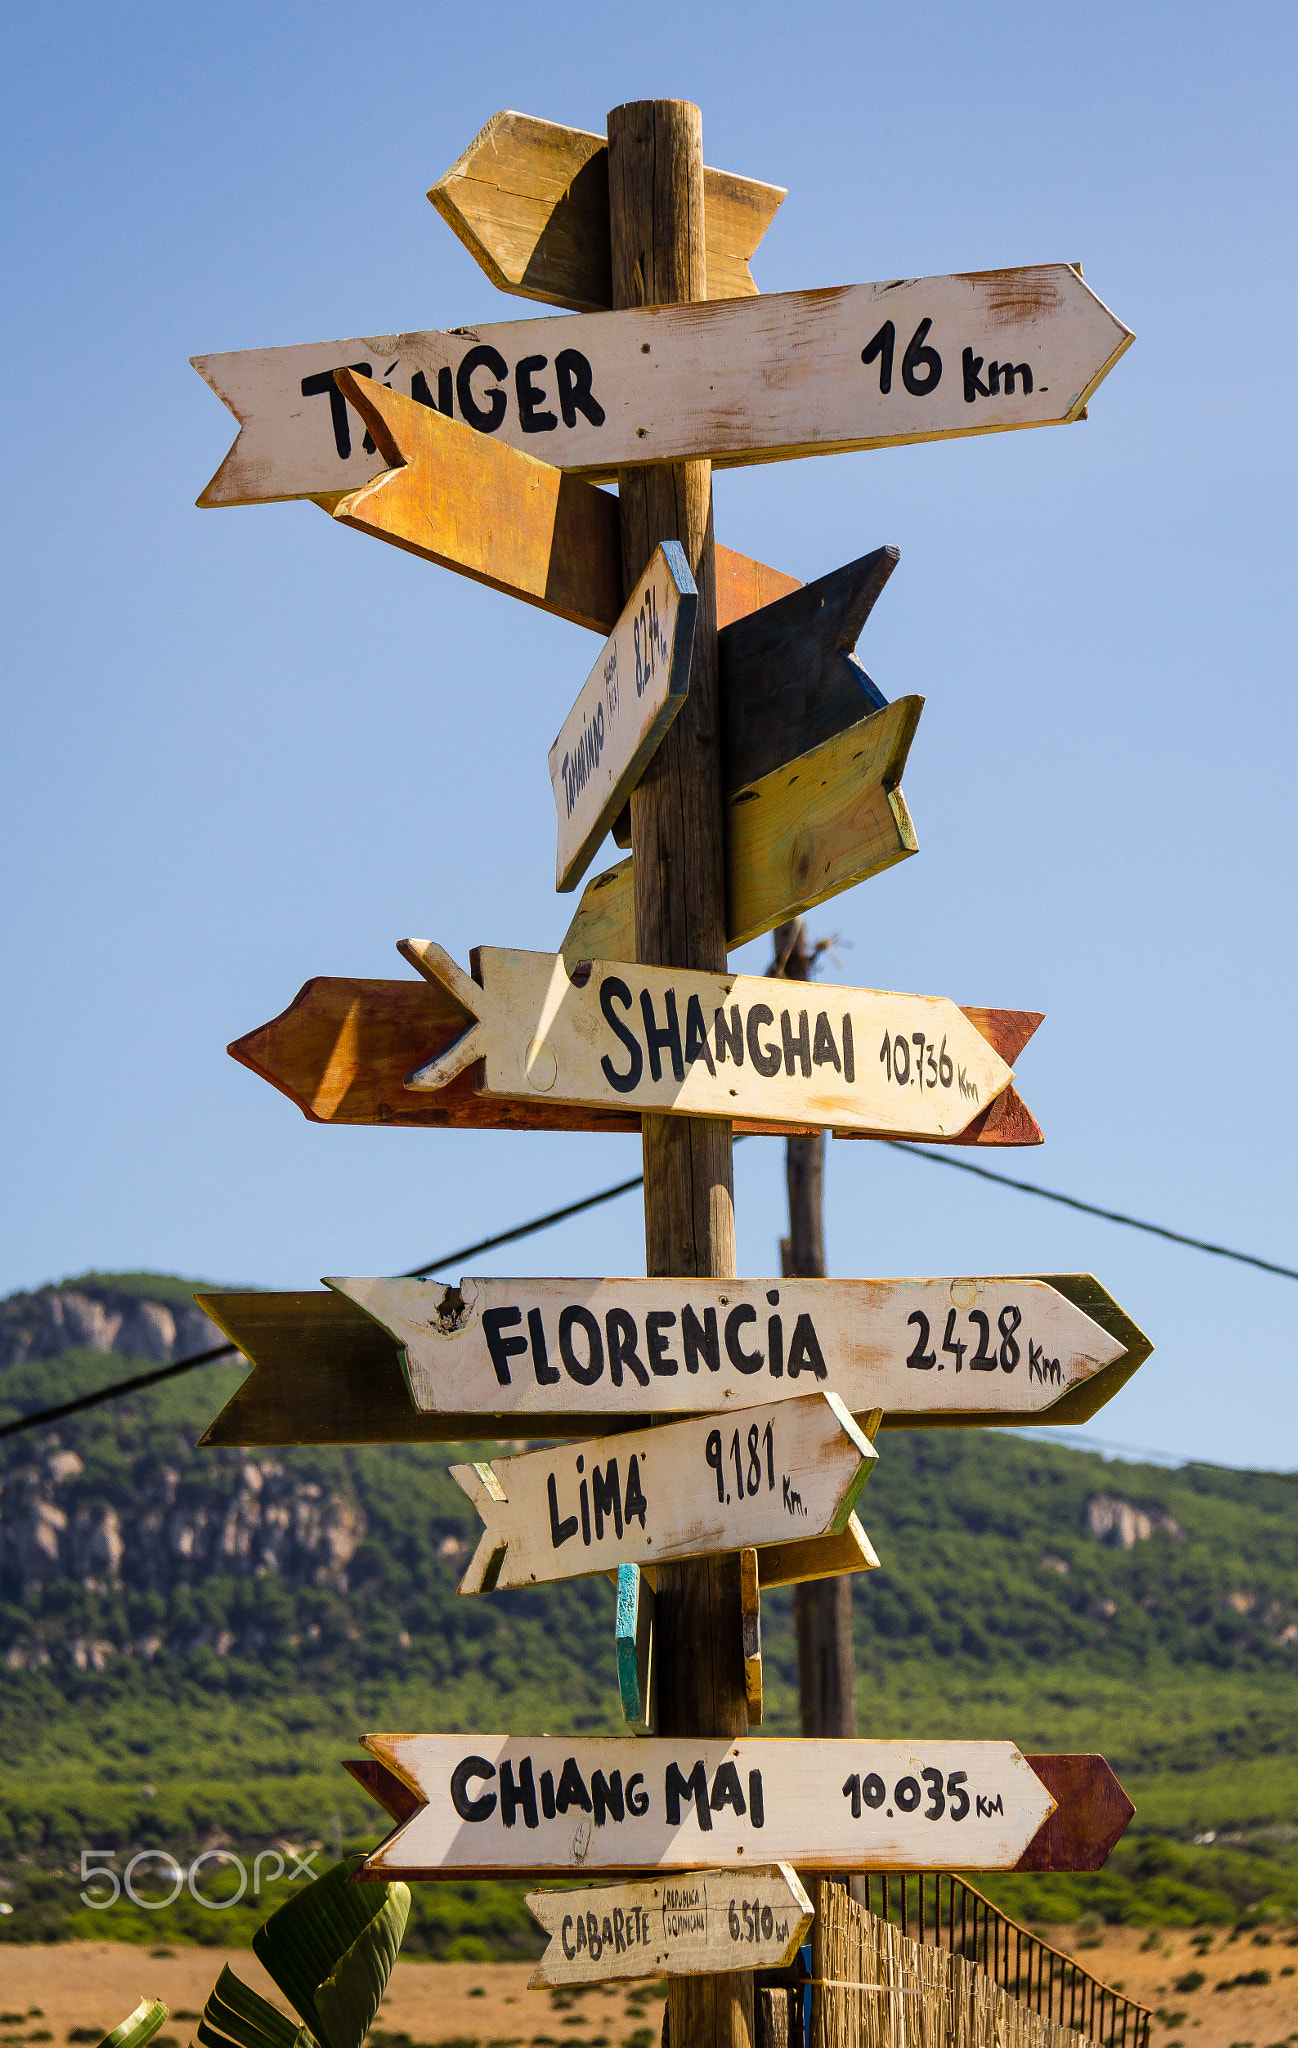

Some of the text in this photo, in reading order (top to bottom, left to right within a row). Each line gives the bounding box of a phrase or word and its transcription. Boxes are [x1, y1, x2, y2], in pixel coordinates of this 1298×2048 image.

[301, 345, 606, 460] TNGER
[861, 317, 942, 397] 16
[634, 584, 660, 698] 8.274
[600, 975, 856, 1093] SHANGHAI
[879, 1027, 954, 1095] 10.736
[906, 1305, 1022, 1374] 2.428
[705, 1420, 776, 1505] 9.181
[450, 1755, 650, 1829] CHIANG
[664, 1759, 765, 1832] MAI
[841, 1767, 971, 1822] 10.035
[561, 1906, 652, 1962] CABARETE
[728, 1896, 774, 1944] 6.510
